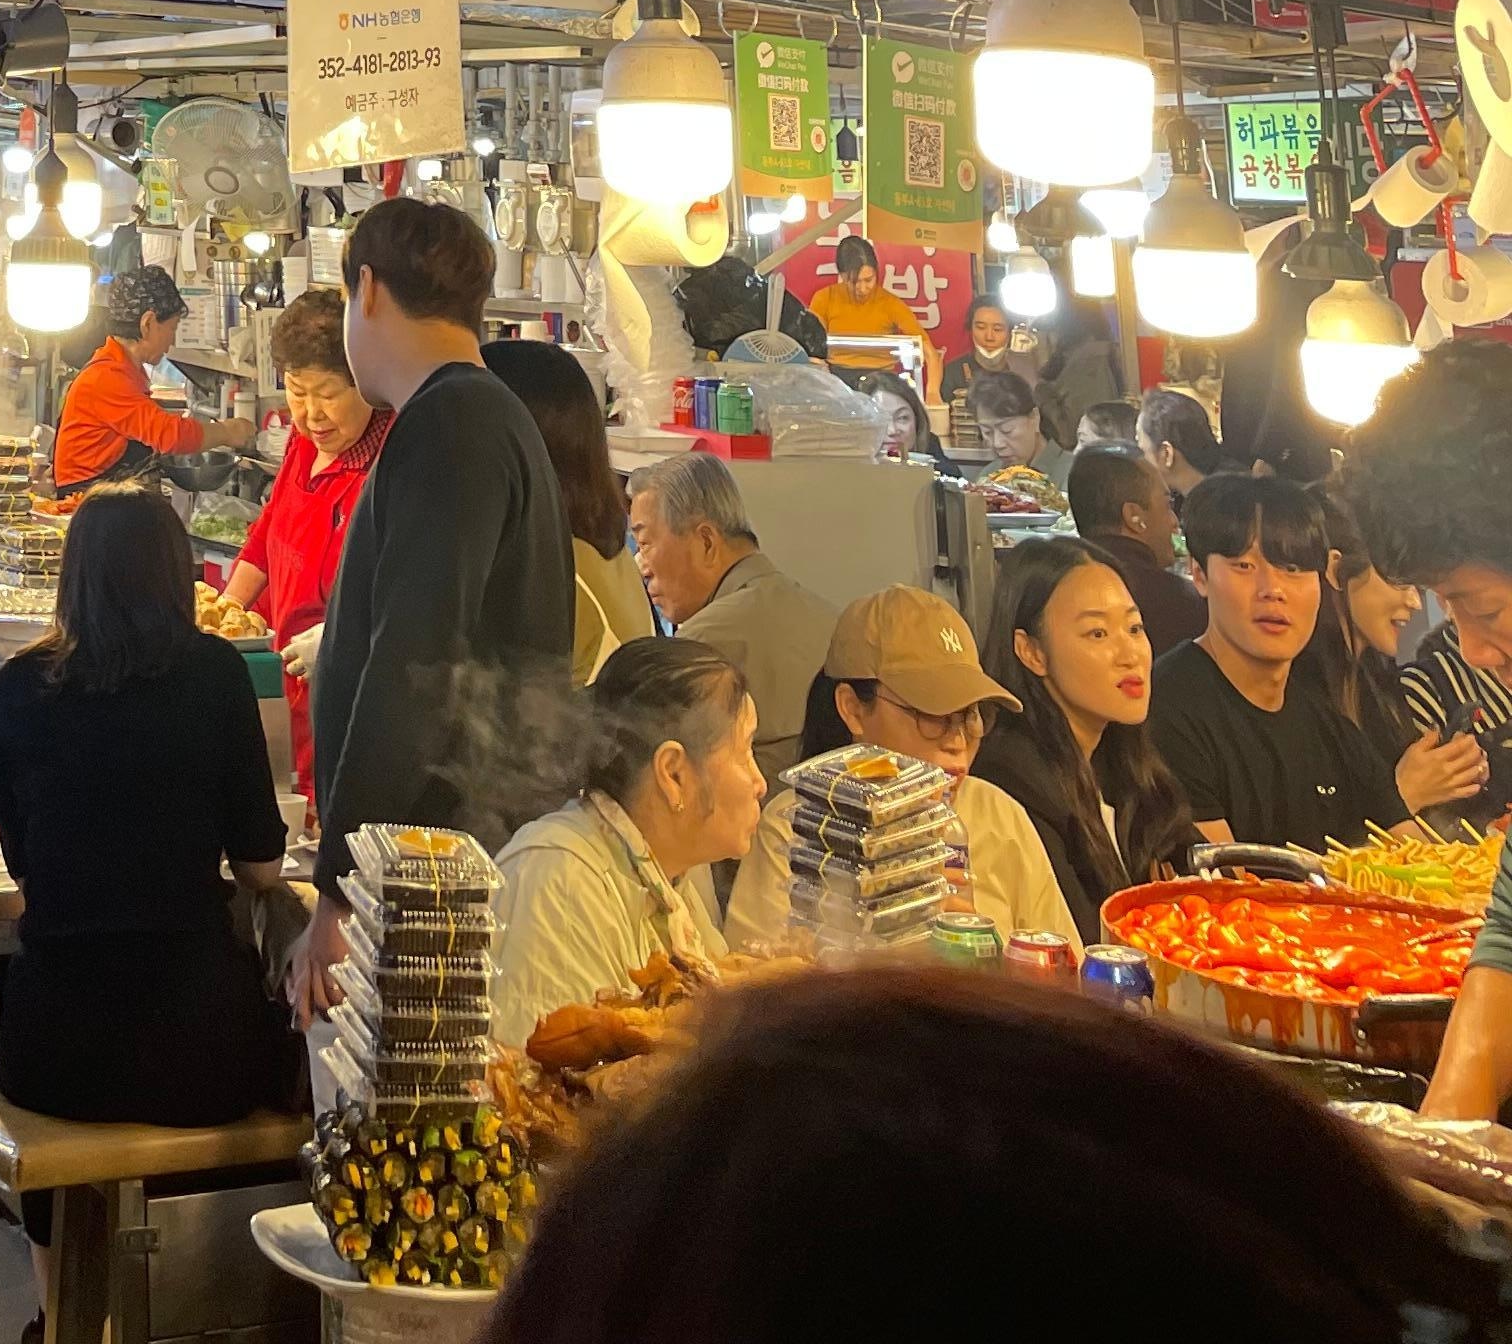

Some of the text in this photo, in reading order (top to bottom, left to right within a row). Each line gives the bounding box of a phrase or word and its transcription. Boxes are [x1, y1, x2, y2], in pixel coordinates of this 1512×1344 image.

[318, 47, 441, 79] 352-4181-2813-93
[1236, 114, 1322, 151] 허파볶음
[1239, 153, 1322, 191] 곱창볶
